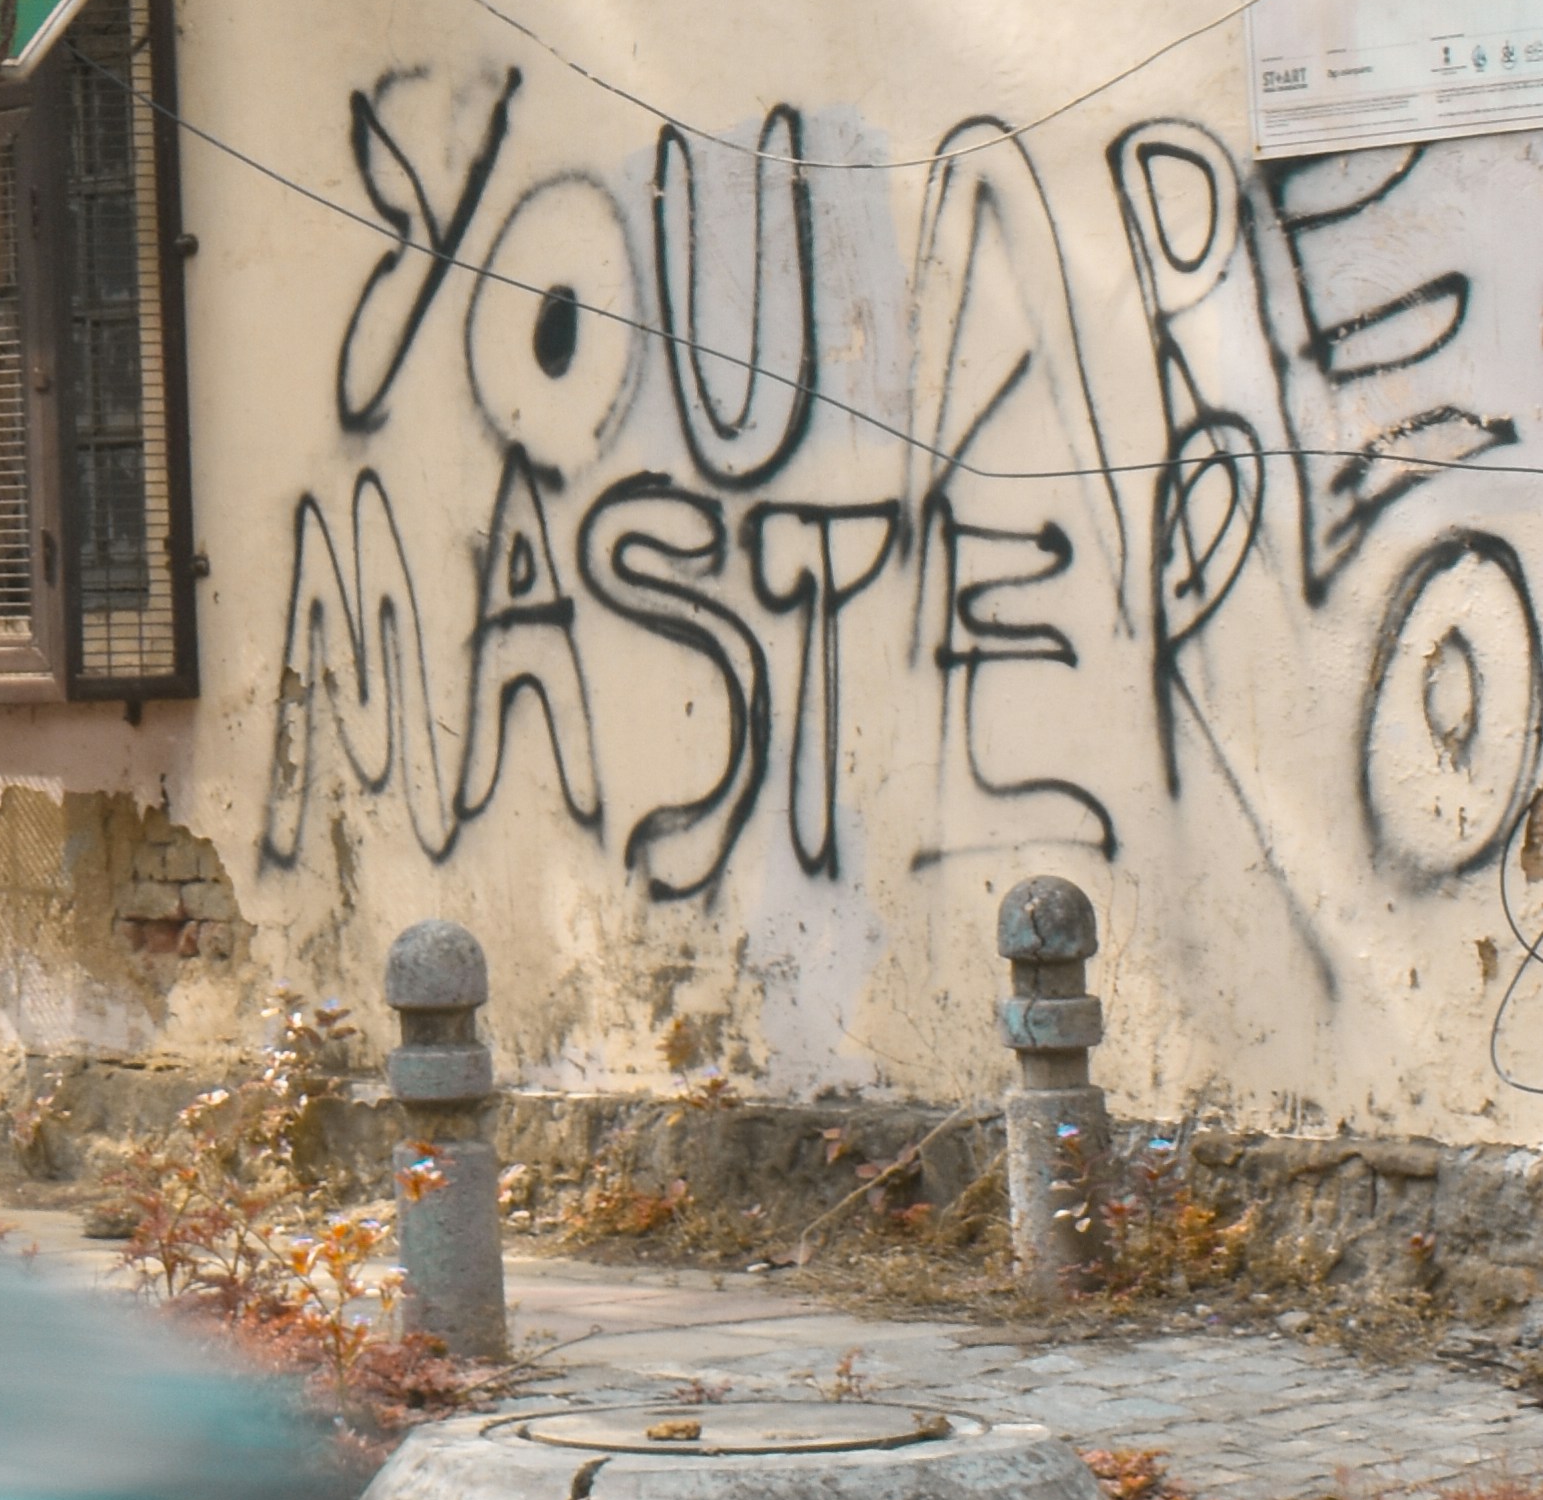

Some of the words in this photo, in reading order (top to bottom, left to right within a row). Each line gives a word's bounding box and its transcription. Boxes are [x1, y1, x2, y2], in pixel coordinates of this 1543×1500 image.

[338, 66, 818, 490] YOU
[903, 115, 1518, 668] ARE
[259, 444, 1340, 1006] MASTER
